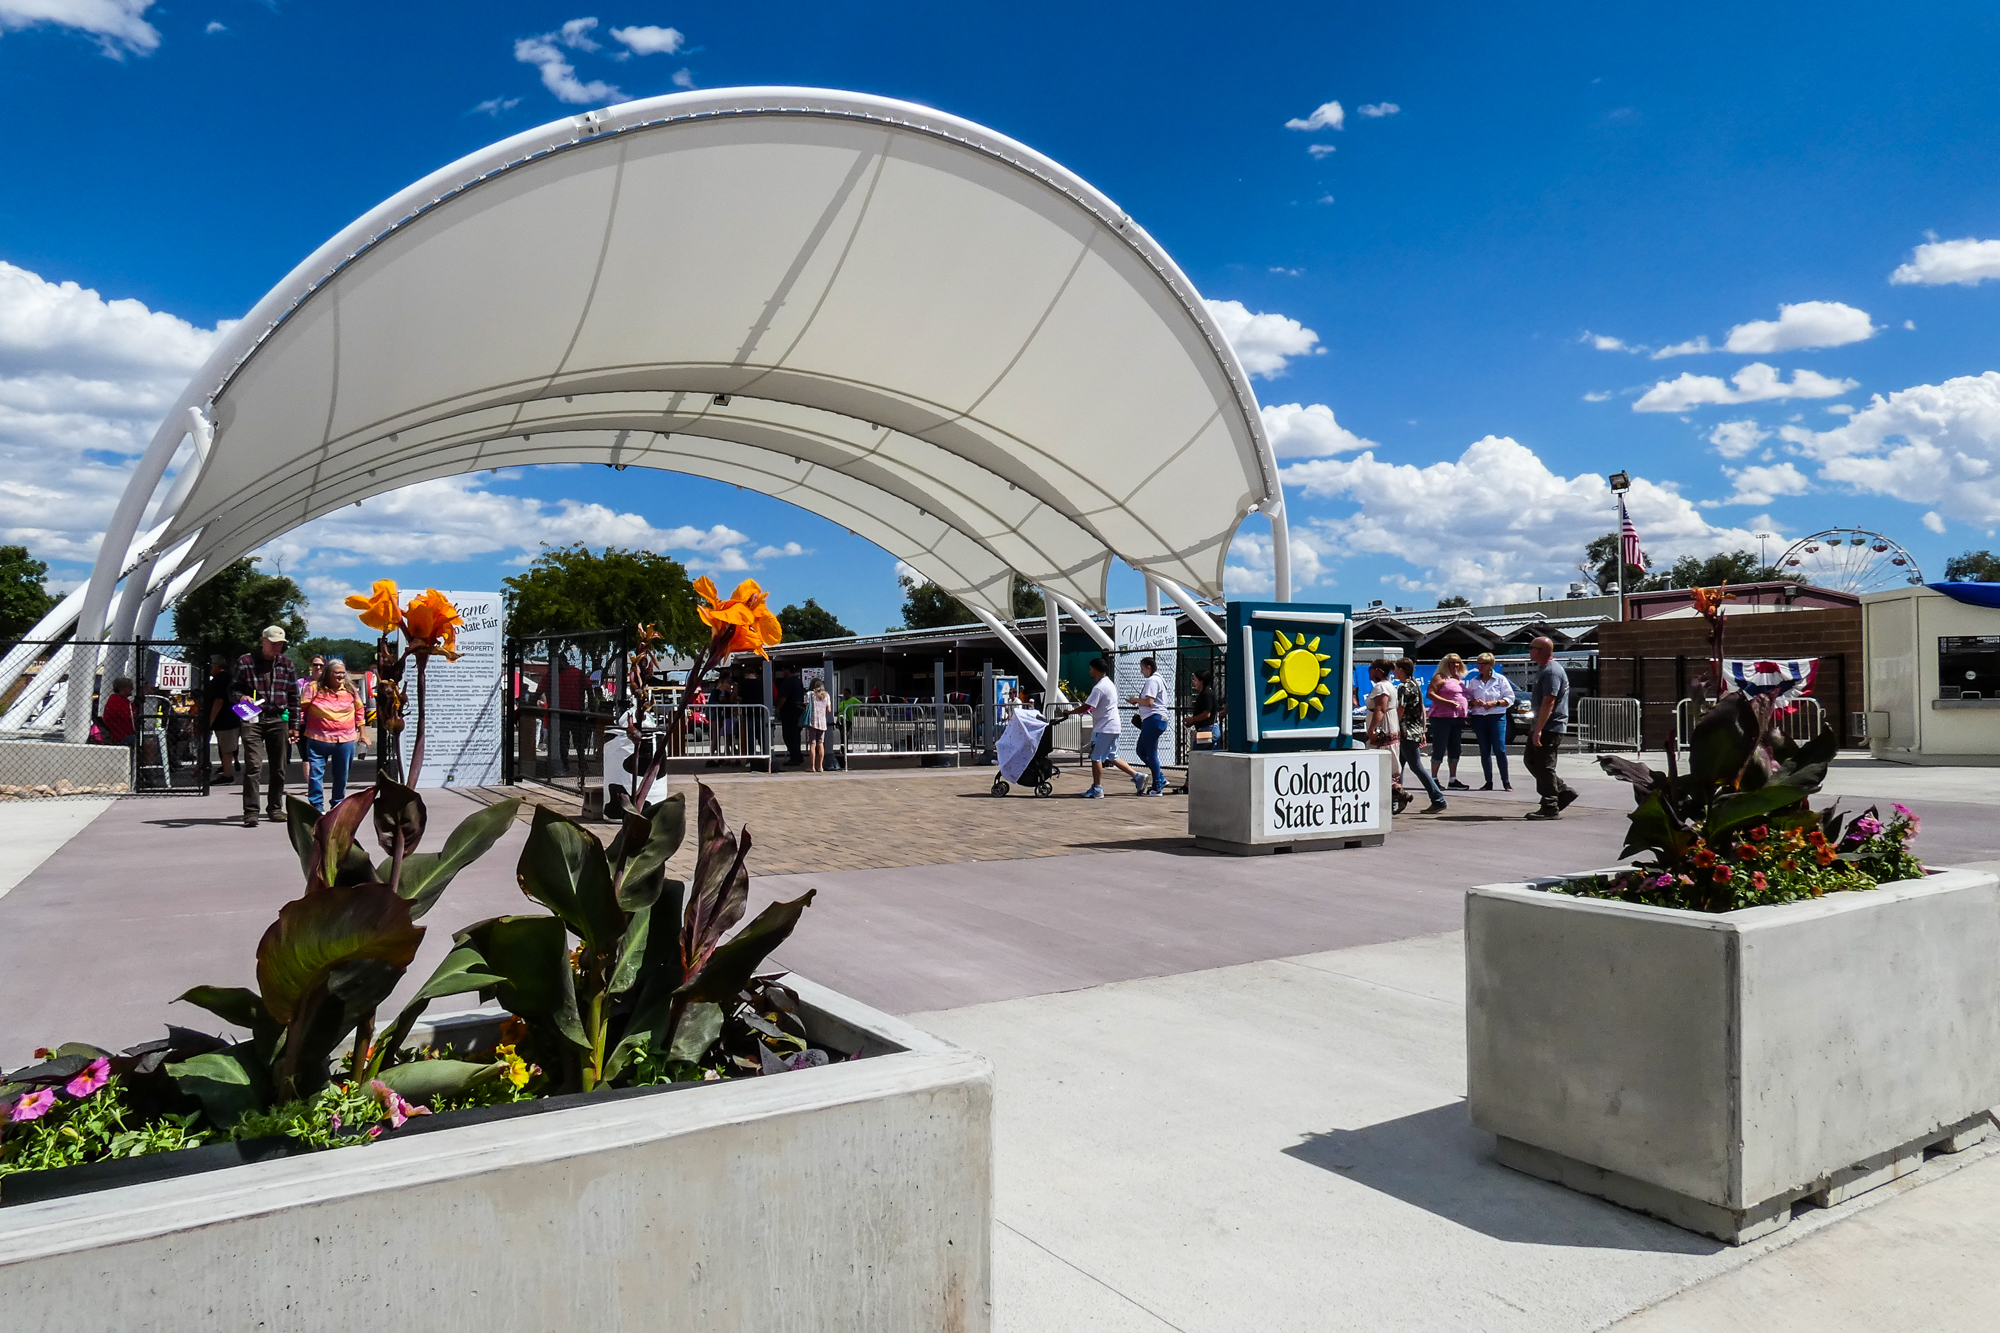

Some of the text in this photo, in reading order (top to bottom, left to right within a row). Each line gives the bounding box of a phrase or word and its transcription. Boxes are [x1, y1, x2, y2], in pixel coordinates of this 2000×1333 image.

[461, 622, 481, 633] State
[482, 617, 498, 629] Fair
[1122, 622, 1170, 643] Welcome
[164, 665, 187, 675] EXIT
[163, 676, 187, 686] ONLY
[1274, 761, 1370, 797] Colorado
[1274, 794, 1370, 829] State Fair
